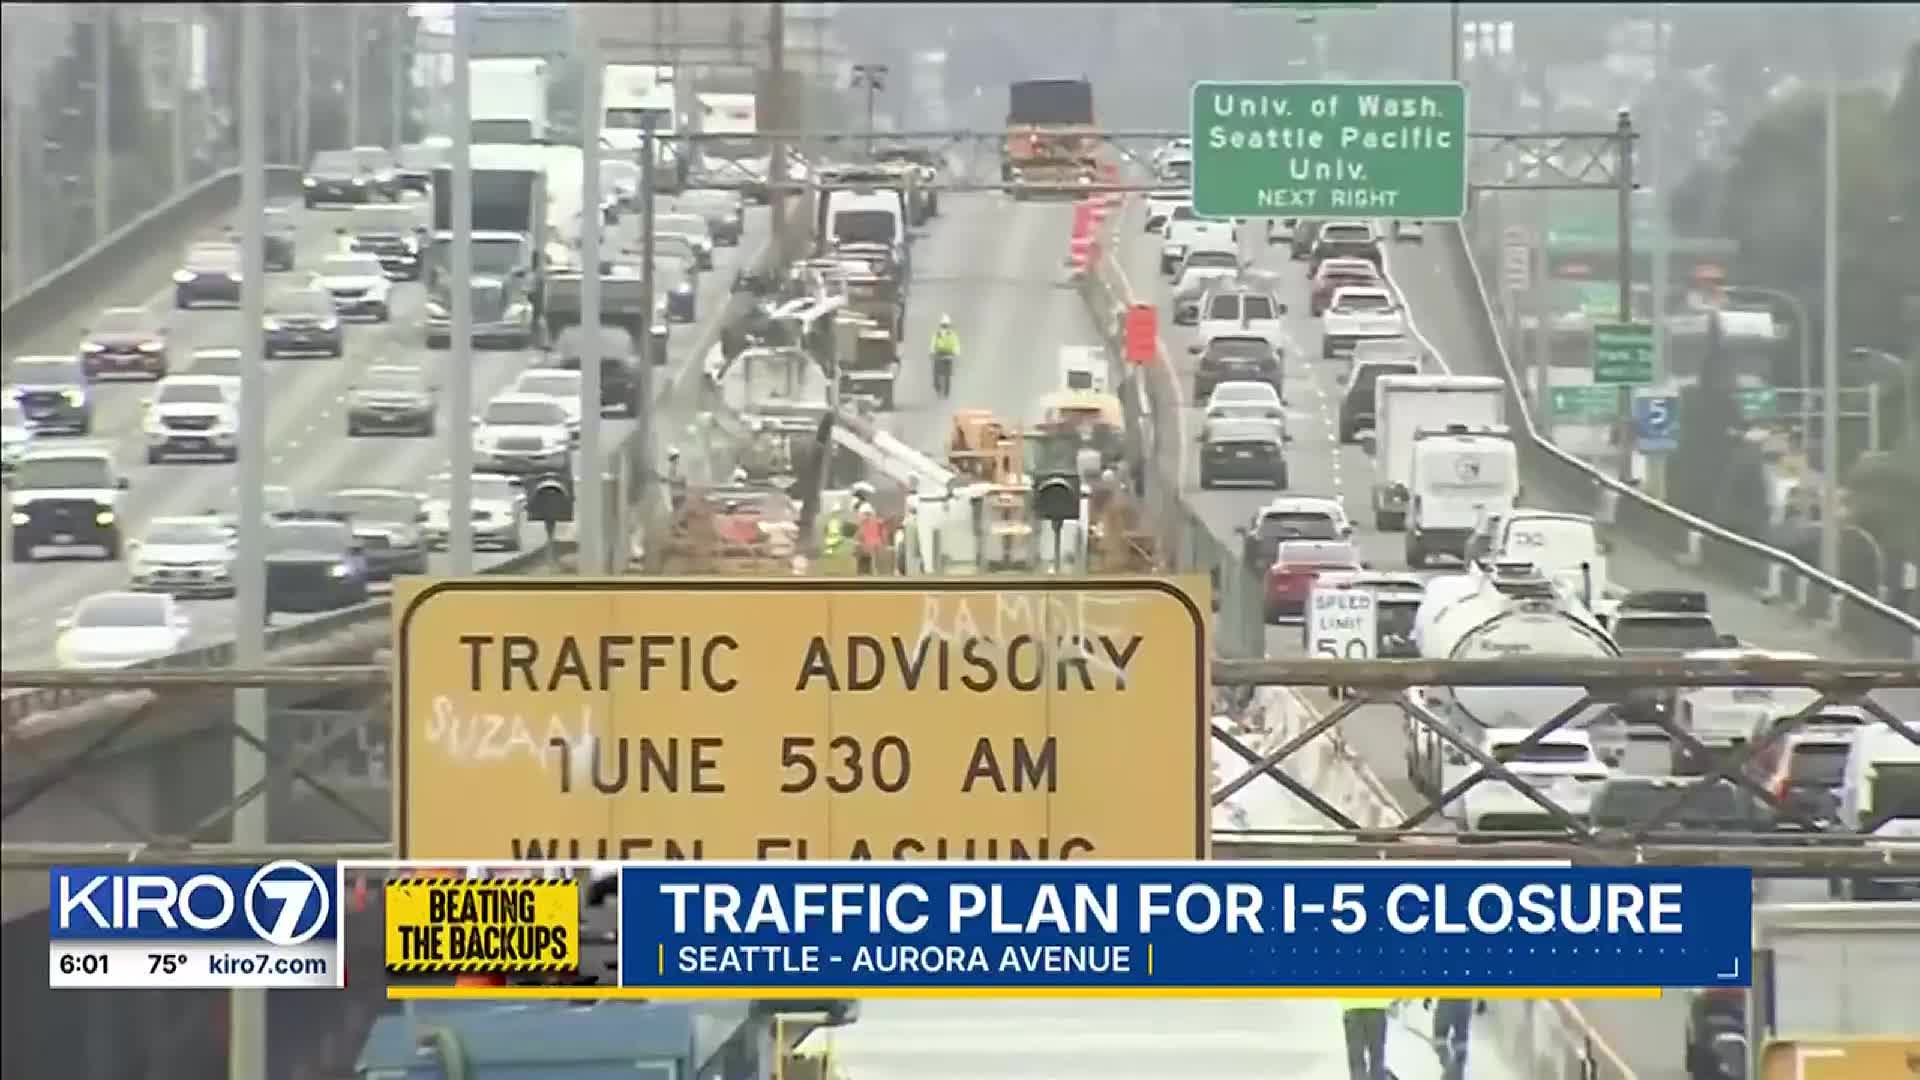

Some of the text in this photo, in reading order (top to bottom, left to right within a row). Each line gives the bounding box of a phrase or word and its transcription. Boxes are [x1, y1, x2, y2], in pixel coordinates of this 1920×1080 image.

[1213, 95, 1444, 117] Univ. of Wash.
[1209, 126, 1452, 149] Seattle Pacific
[1289, 157, 1368, 180] Univ.
[1257, 188, 1399, 207] NEXT RIGHT
[1648, 399, 1668, 425] 5
[459, 634, 1143, 692] TRAFFIC ADVISORY
[780, 735, 911, 793] 530
[961, 736, 1057, 793] AM
